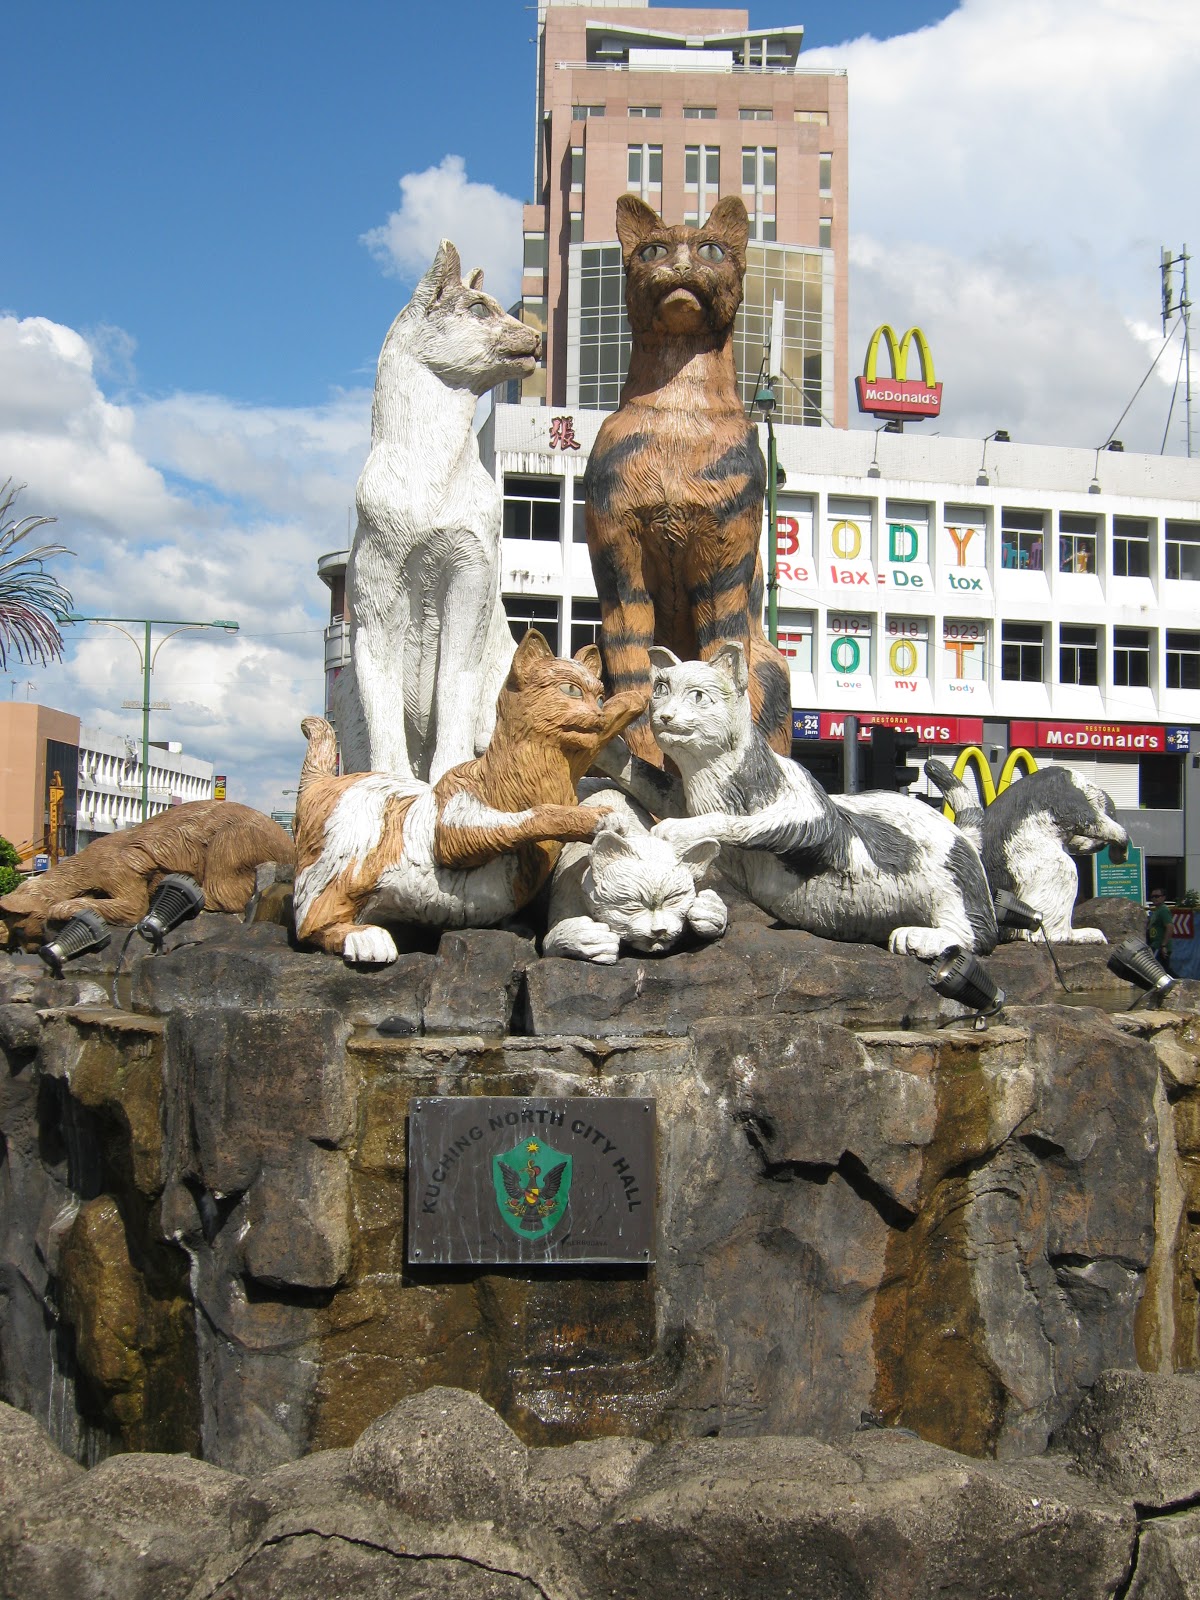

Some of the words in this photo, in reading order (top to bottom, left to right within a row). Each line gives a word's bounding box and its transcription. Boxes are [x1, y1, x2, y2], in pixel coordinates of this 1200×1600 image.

[865, 389, 939, 405] McDonald's
[836, 680, 862, 688] Love
[895, 680, 918, 691] my
[949, 684, 974, 694] body
[804, 720, 818, 729] 24
[1085, 725, 1121, 733] RESTORAN
[1046, 731, 1159, 748] McDonald's
[1176, 734, 1189, 744] 24
[422, 1125, 484, 1214] KUCHING
[488, 1110, 566, 1132] NORTH
[571, 1119, 617, 1155] CITY
[612, 1156, 642, 1213] HALL
